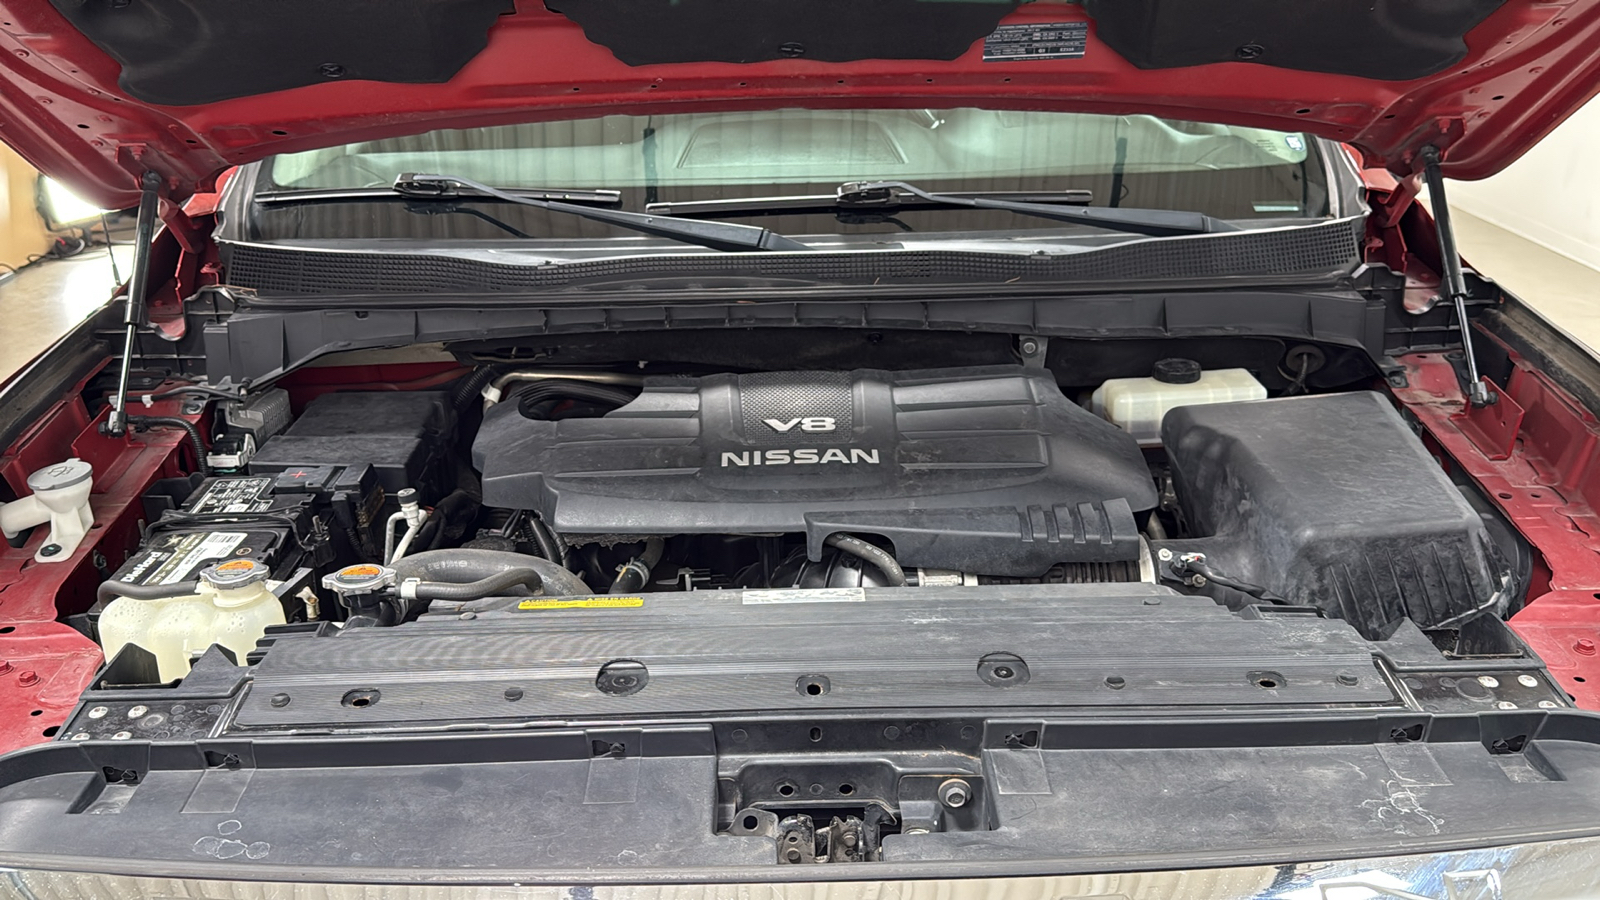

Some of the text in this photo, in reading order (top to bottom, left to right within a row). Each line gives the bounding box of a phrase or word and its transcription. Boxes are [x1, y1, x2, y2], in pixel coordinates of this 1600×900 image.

[762, 417, 836, 434] V8
[721, 449, 880, 467] NISSAN
[120, 551, 163, 582] DieHard
